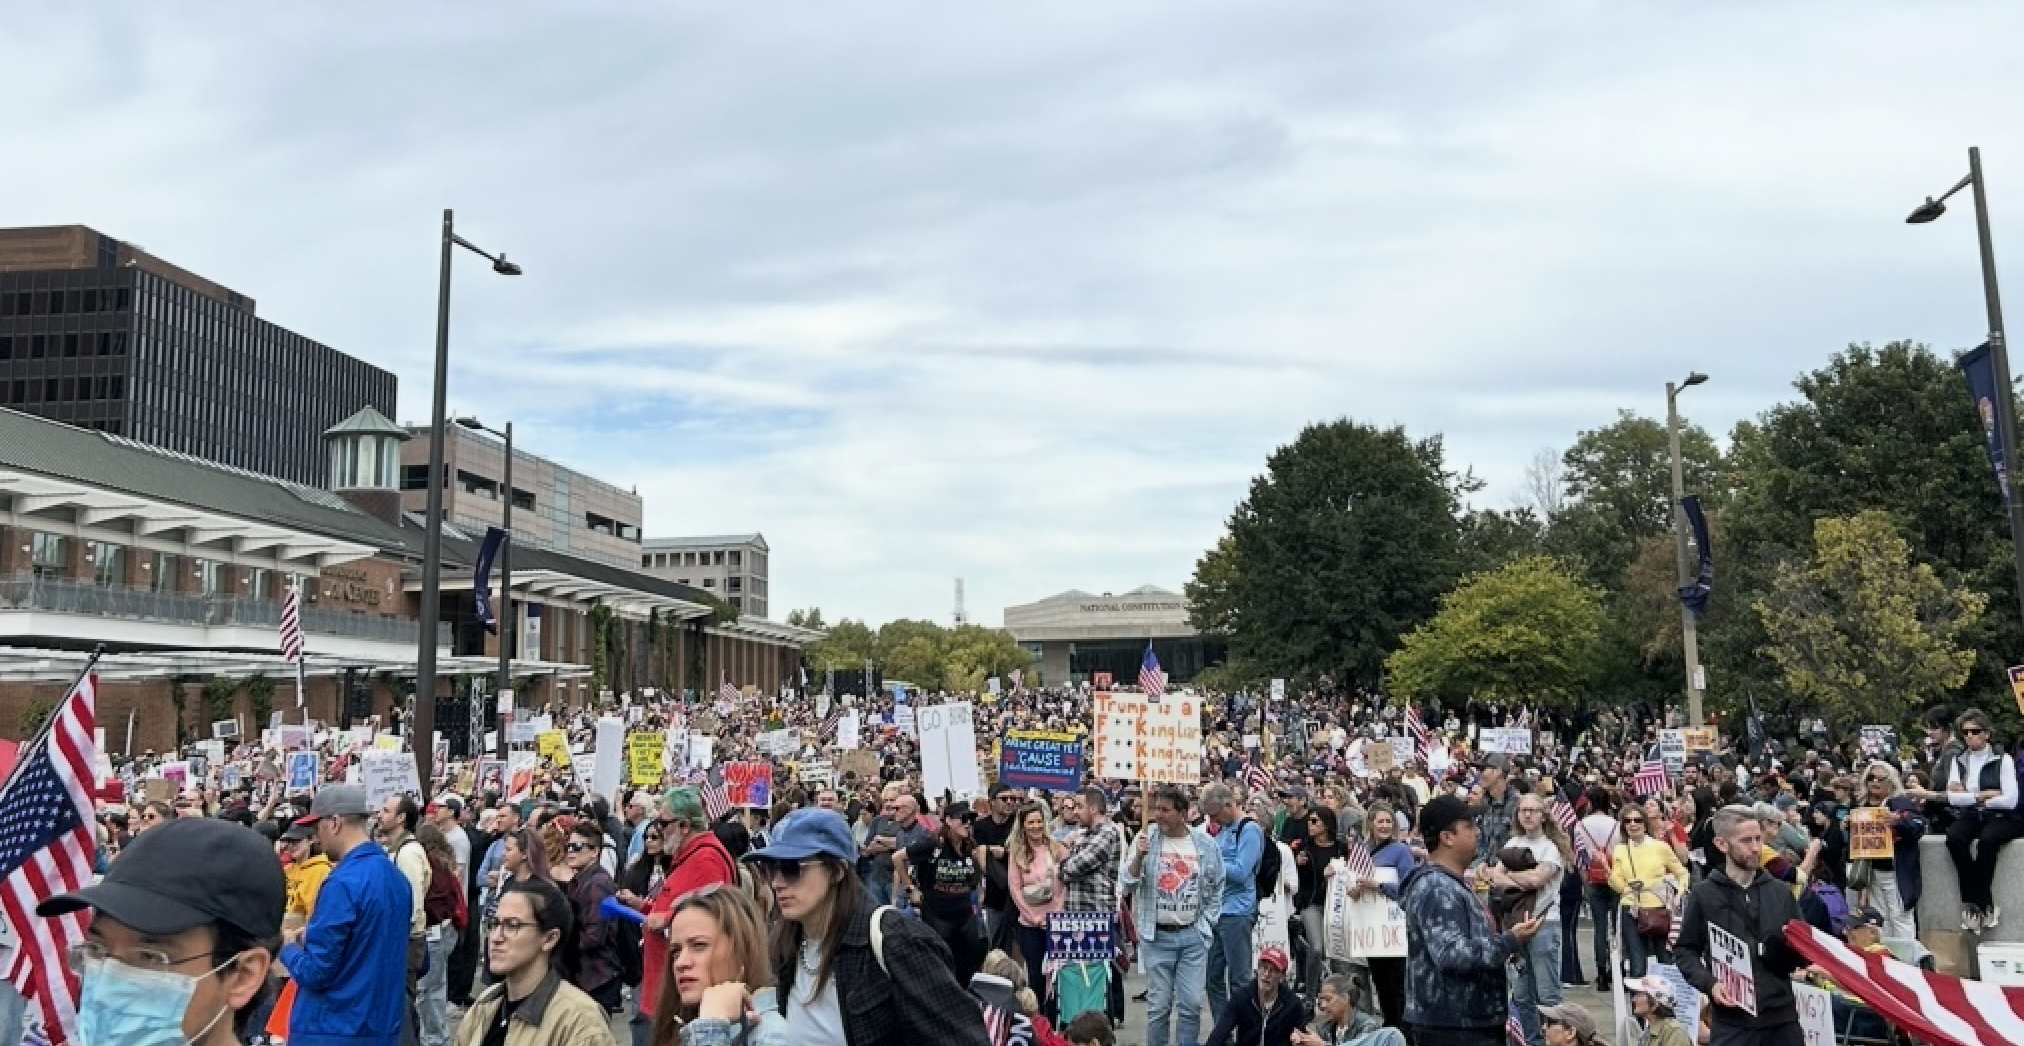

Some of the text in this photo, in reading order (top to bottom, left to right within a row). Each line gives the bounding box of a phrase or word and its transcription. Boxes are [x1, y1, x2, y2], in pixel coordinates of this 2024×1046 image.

[1080, 604, 1120, 612] NATIONAL
[1122, 603, 1180, 612] CONSTITUTION
[1096, 695, 1148, 718] Trump
[921, 709, 941, 731] GO
[1033, 740, 1061, 752] GREAT
[1353, 926, 1375, 950] NO
[1711, 925, 1745, 961] TIRED
